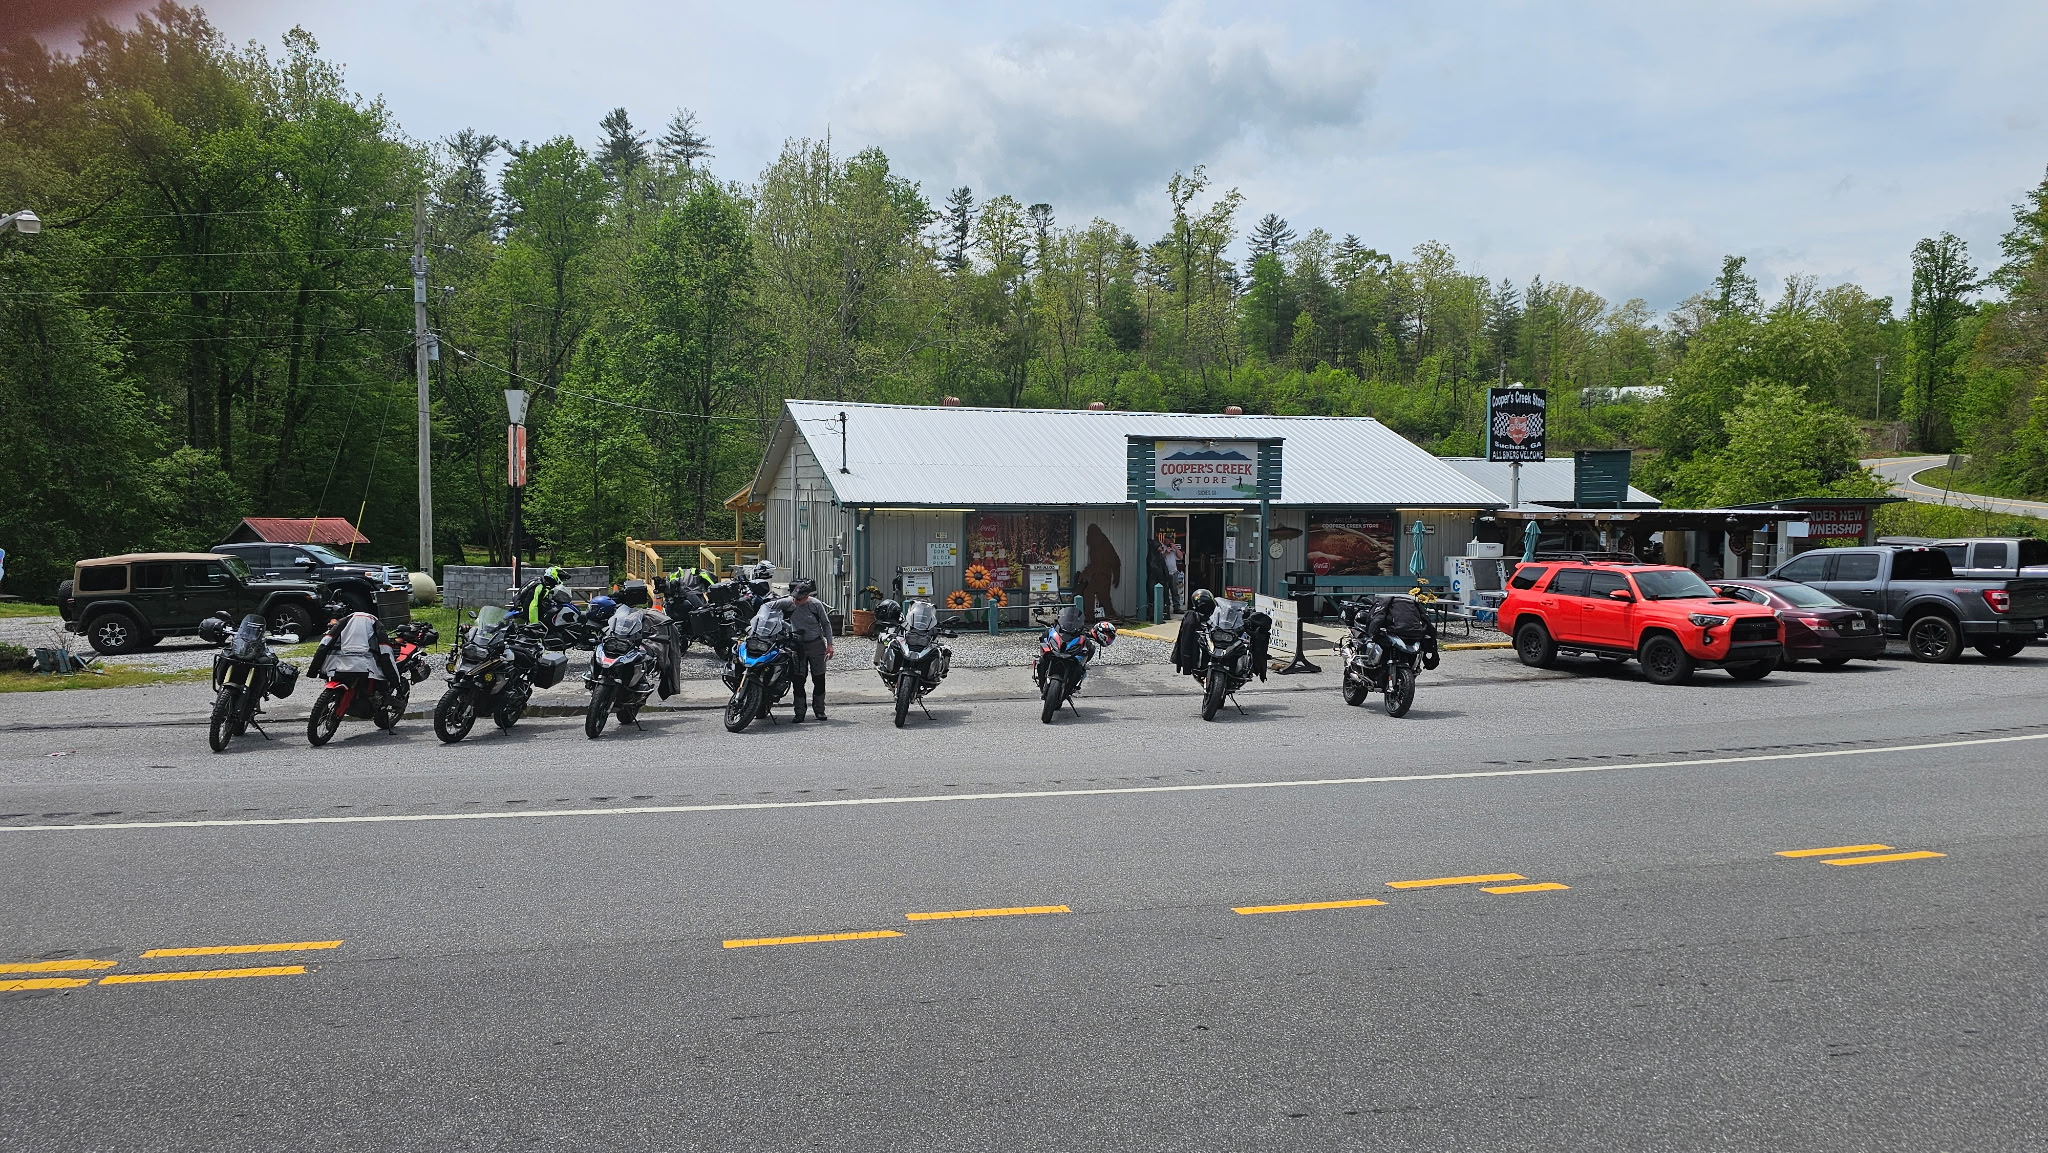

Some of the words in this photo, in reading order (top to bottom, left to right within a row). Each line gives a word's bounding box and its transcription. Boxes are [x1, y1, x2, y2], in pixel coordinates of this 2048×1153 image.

[1492, 392, 1514, 408] Cooper's
[1515, 391, 1531, 404] Creek
[1532, 393, 1545, 409] Store
[1495, 441, 1527, 450] Suches,
[1492, 451, 1502, 459] ALL
[1503, 451, 1519, 459] BIKERS
[1520, 451, 1543, 459] WELCOME
[1161, 463, 1214, 475] COOPER'S
[1215, 463, 1253, 475] CREEK
[1809, 511, 1837, 521] NDER
[1839, 511, 1863, 520] NEW
[1809, 524, 1863, 535] WNERSHIP
